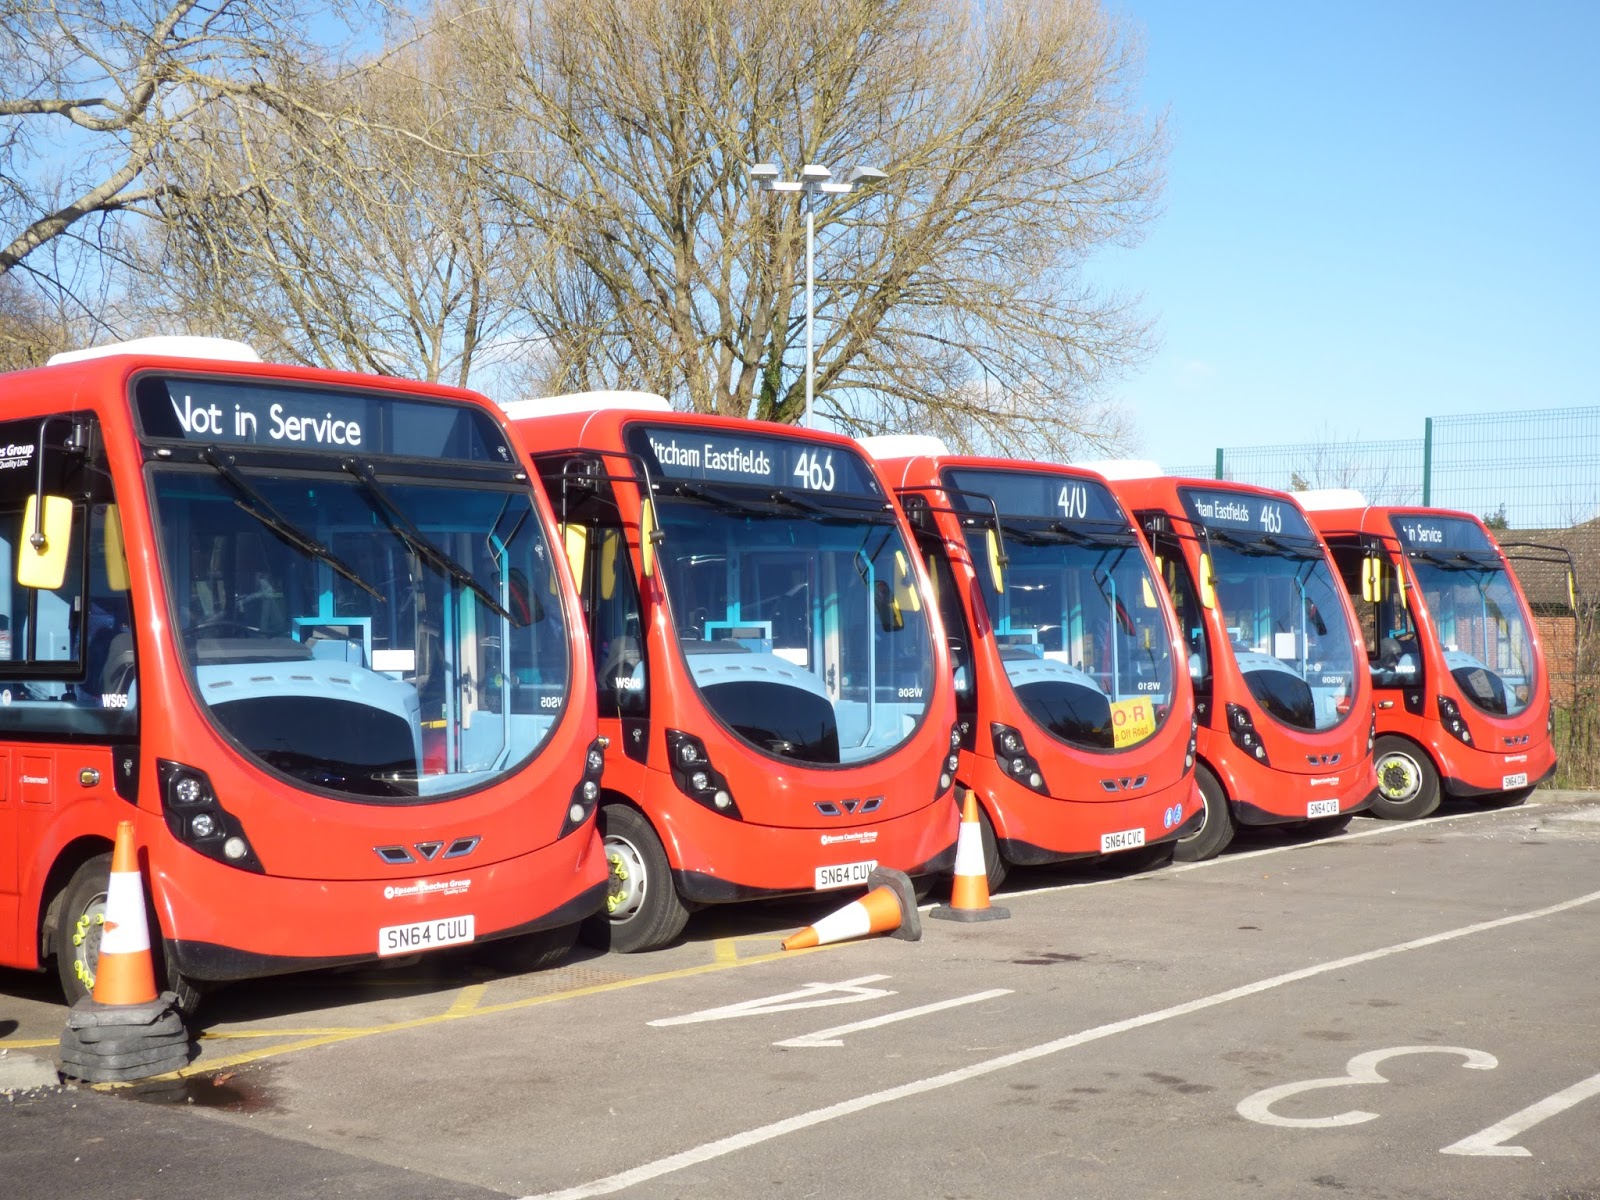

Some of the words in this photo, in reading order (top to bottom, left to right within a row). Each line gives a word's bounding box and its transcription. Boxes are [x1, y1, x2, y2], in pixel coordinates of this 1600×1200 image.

[170, 395, 223, 435] Not
[235, 403, 257, 437] in
[269, 404, 362, 446] Service
[6, 444, 35, 458] Group
[650, 437, 699, 468] itcham
[704, 444, 770, 476] Eastfields
[17, 459, 29, 467] Line
[1214, 501, 1250, 522] Eastfields
[1408, 525, 1416, 541] in
[1417, 523, 1443, 543] Service
[615, 677, 641, 689] WS06
[102, 694, 128, 708] WS05
[1133, 725, 1149, 738] Road
[1310, 803, 1326, 815] SN64
[1105, 834, 1126, 849] SN64
[1127, 831, 1142, 846] CVC
[821, 866, 850, 885] SN64
[394, 887, 419, 897] Epsom
[449, 879, 472, 889] Group
[388, 925, 431, 949] SN64
[437, 919, 467, 941] CUU
